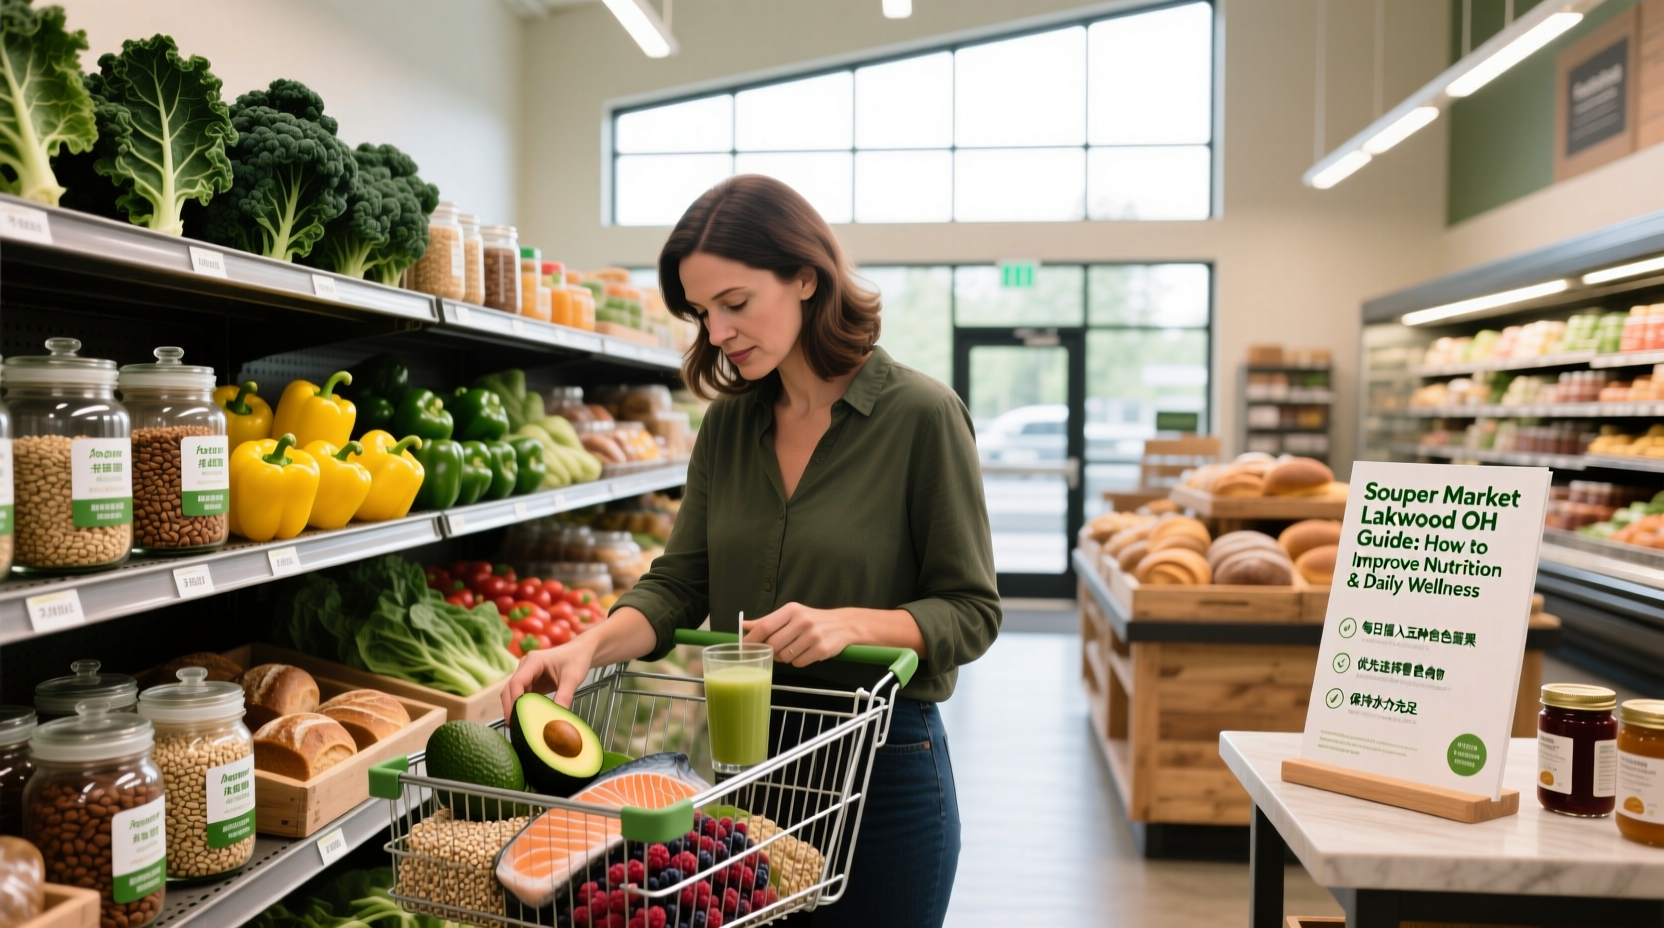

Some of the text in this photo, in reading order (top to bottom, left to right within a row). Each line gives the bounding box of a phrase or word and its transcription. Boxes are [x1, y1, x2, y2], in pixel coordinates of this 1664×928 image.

[1364, 482, 1521, 508] Souper Market
[1361, 506, 1498, 531] Lakwood OH
[1357, 529, 1488, 555] Guide: How to
[1352, 552, 1502, 577] Improve Nutrition
[1347, 573, 1480, 598] & Daily Wellness
